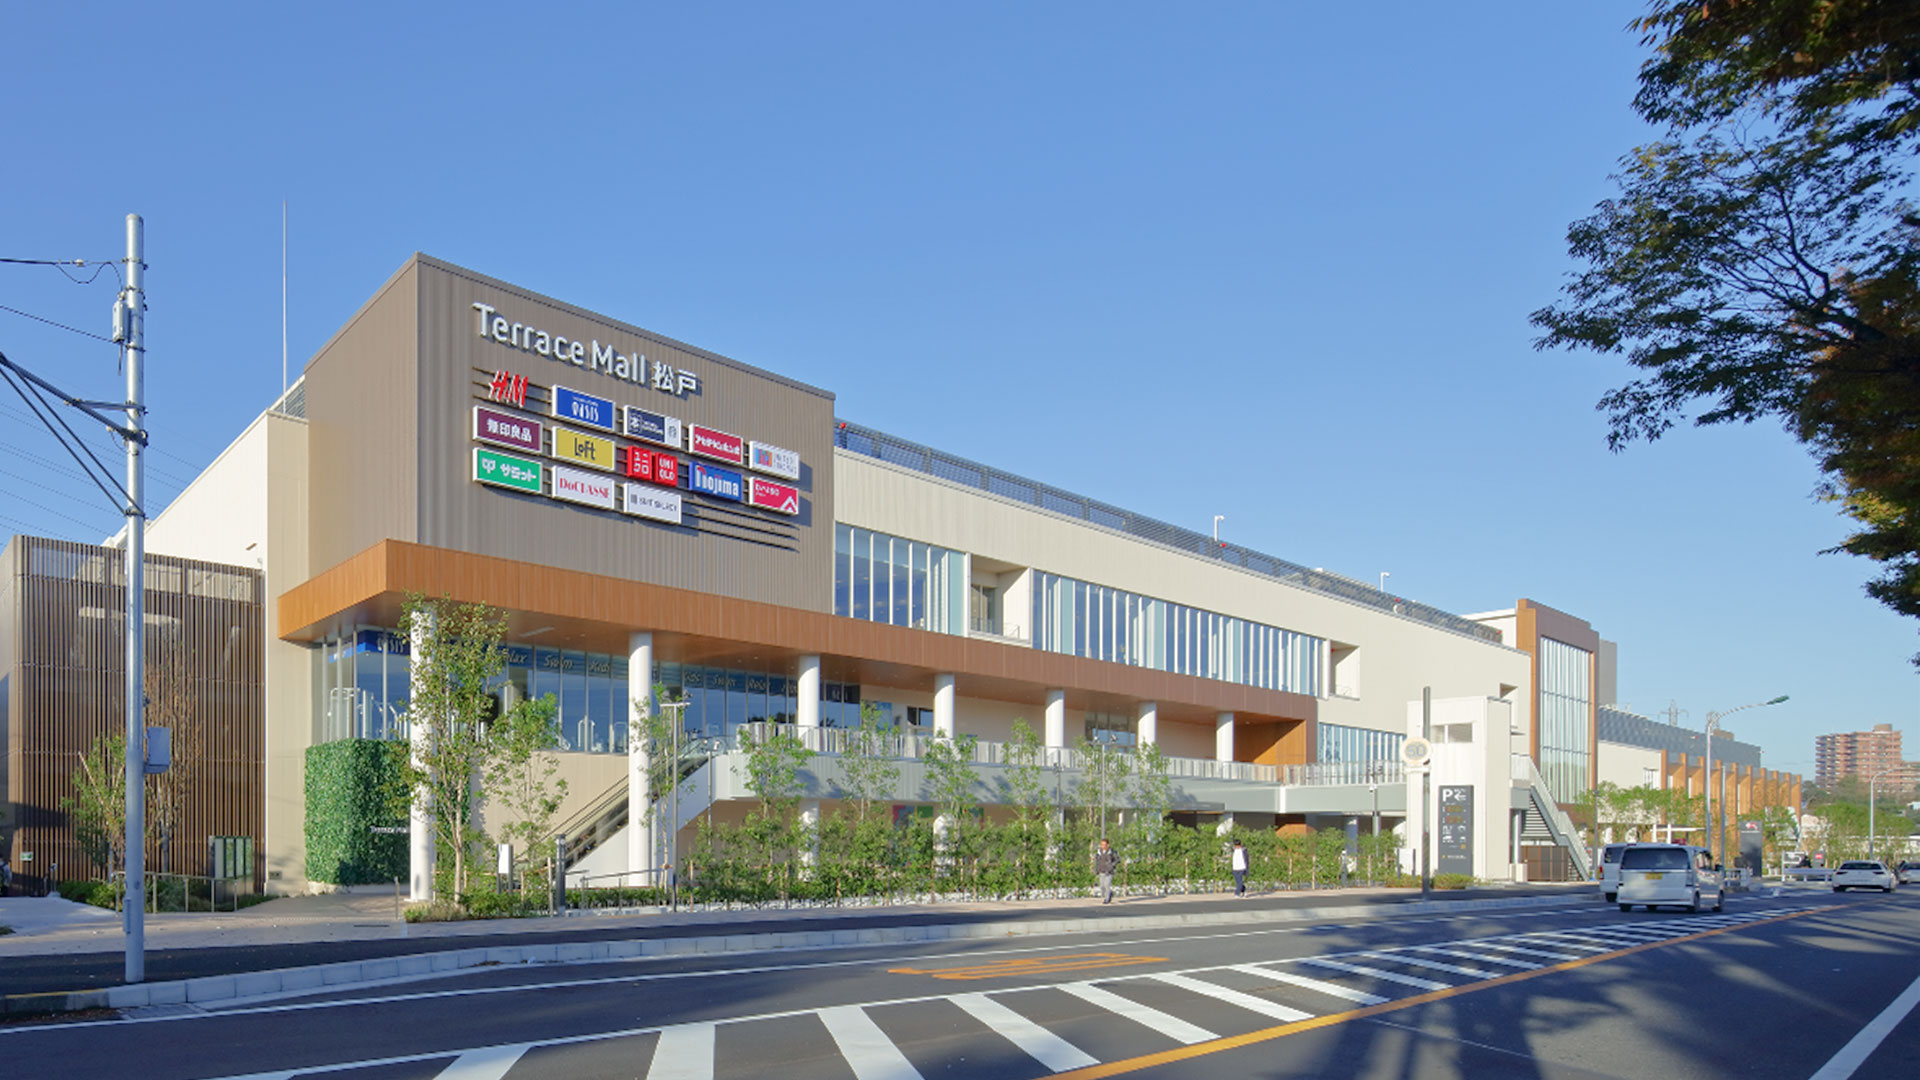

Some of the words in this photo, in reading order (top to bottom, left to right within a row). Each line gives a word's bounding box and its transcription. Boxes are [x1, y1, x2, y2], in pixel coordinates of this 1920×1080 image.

[472, 301, 585, 365] Terrace
[591, 339, 646, 385] Mall
[652, 360, 697, 396] 松戸
[487, 418, 532, 443] 無印良品
[500, 463, 537, 482] サミット
[1406, 743, 1427, 759] 50
[1442, 788, 1453, 802] P
